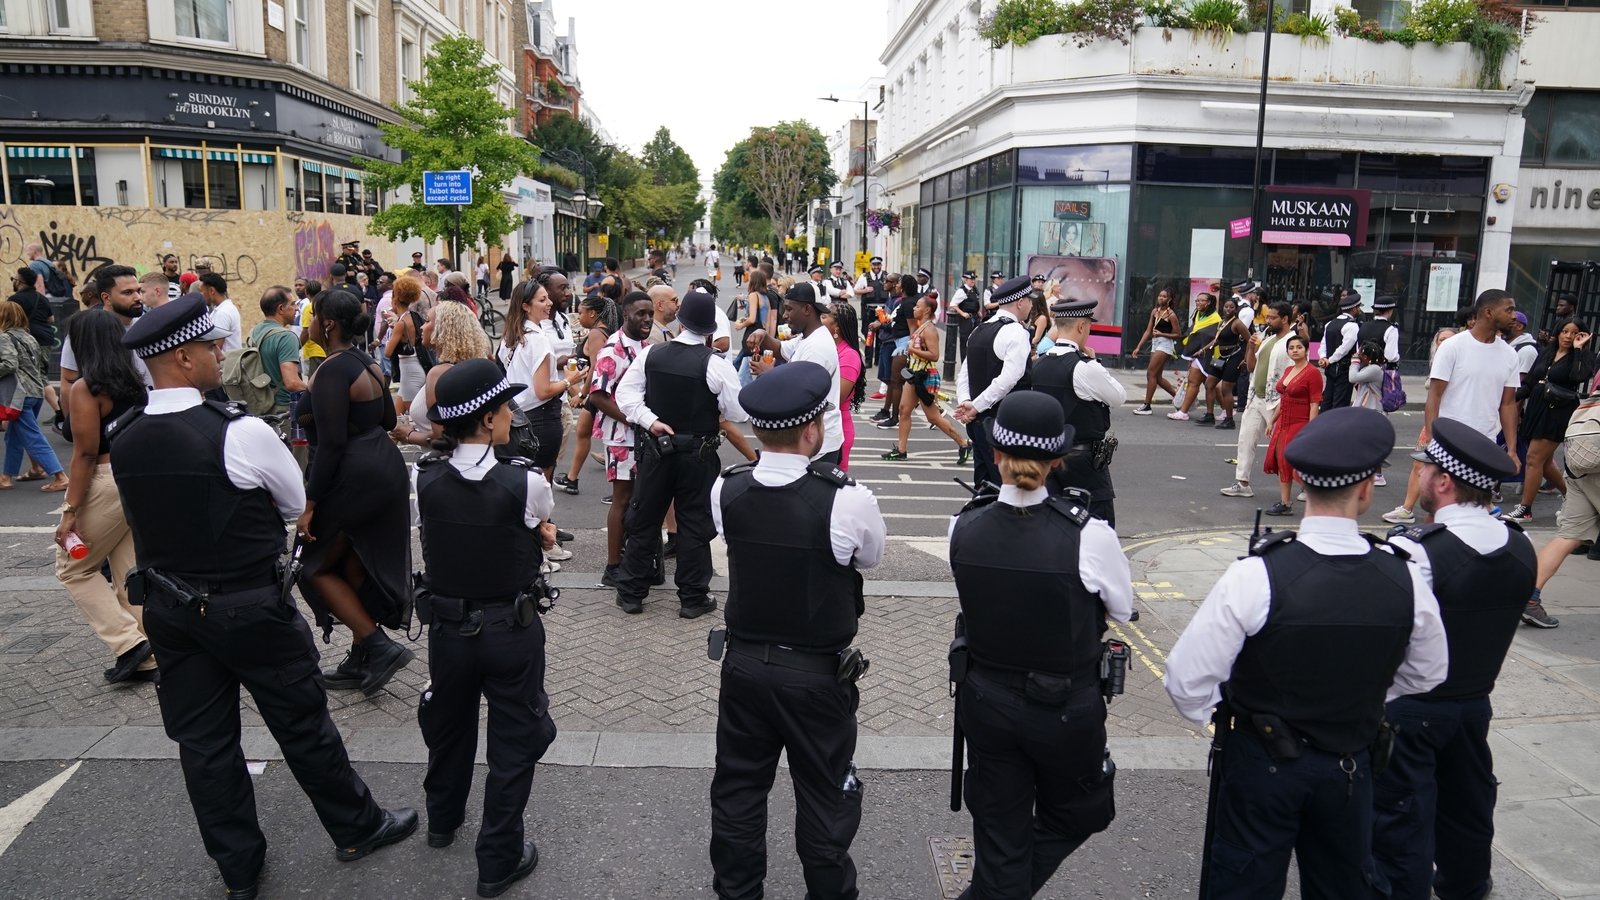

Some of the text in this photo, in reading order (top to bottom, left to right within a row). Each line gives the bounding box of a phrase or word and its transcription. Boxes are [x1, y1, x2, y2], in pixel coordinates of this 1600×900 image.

[191, 103, 250, 118] BROOKLYN
[1530, 179, 1600, 210] nine
[1056, 202, 1088, 214] NAILS
[1271, 200, 1352, 216] MUSKAAN
[1271, 217, 1350, 229] HAIR & BEAUTY
